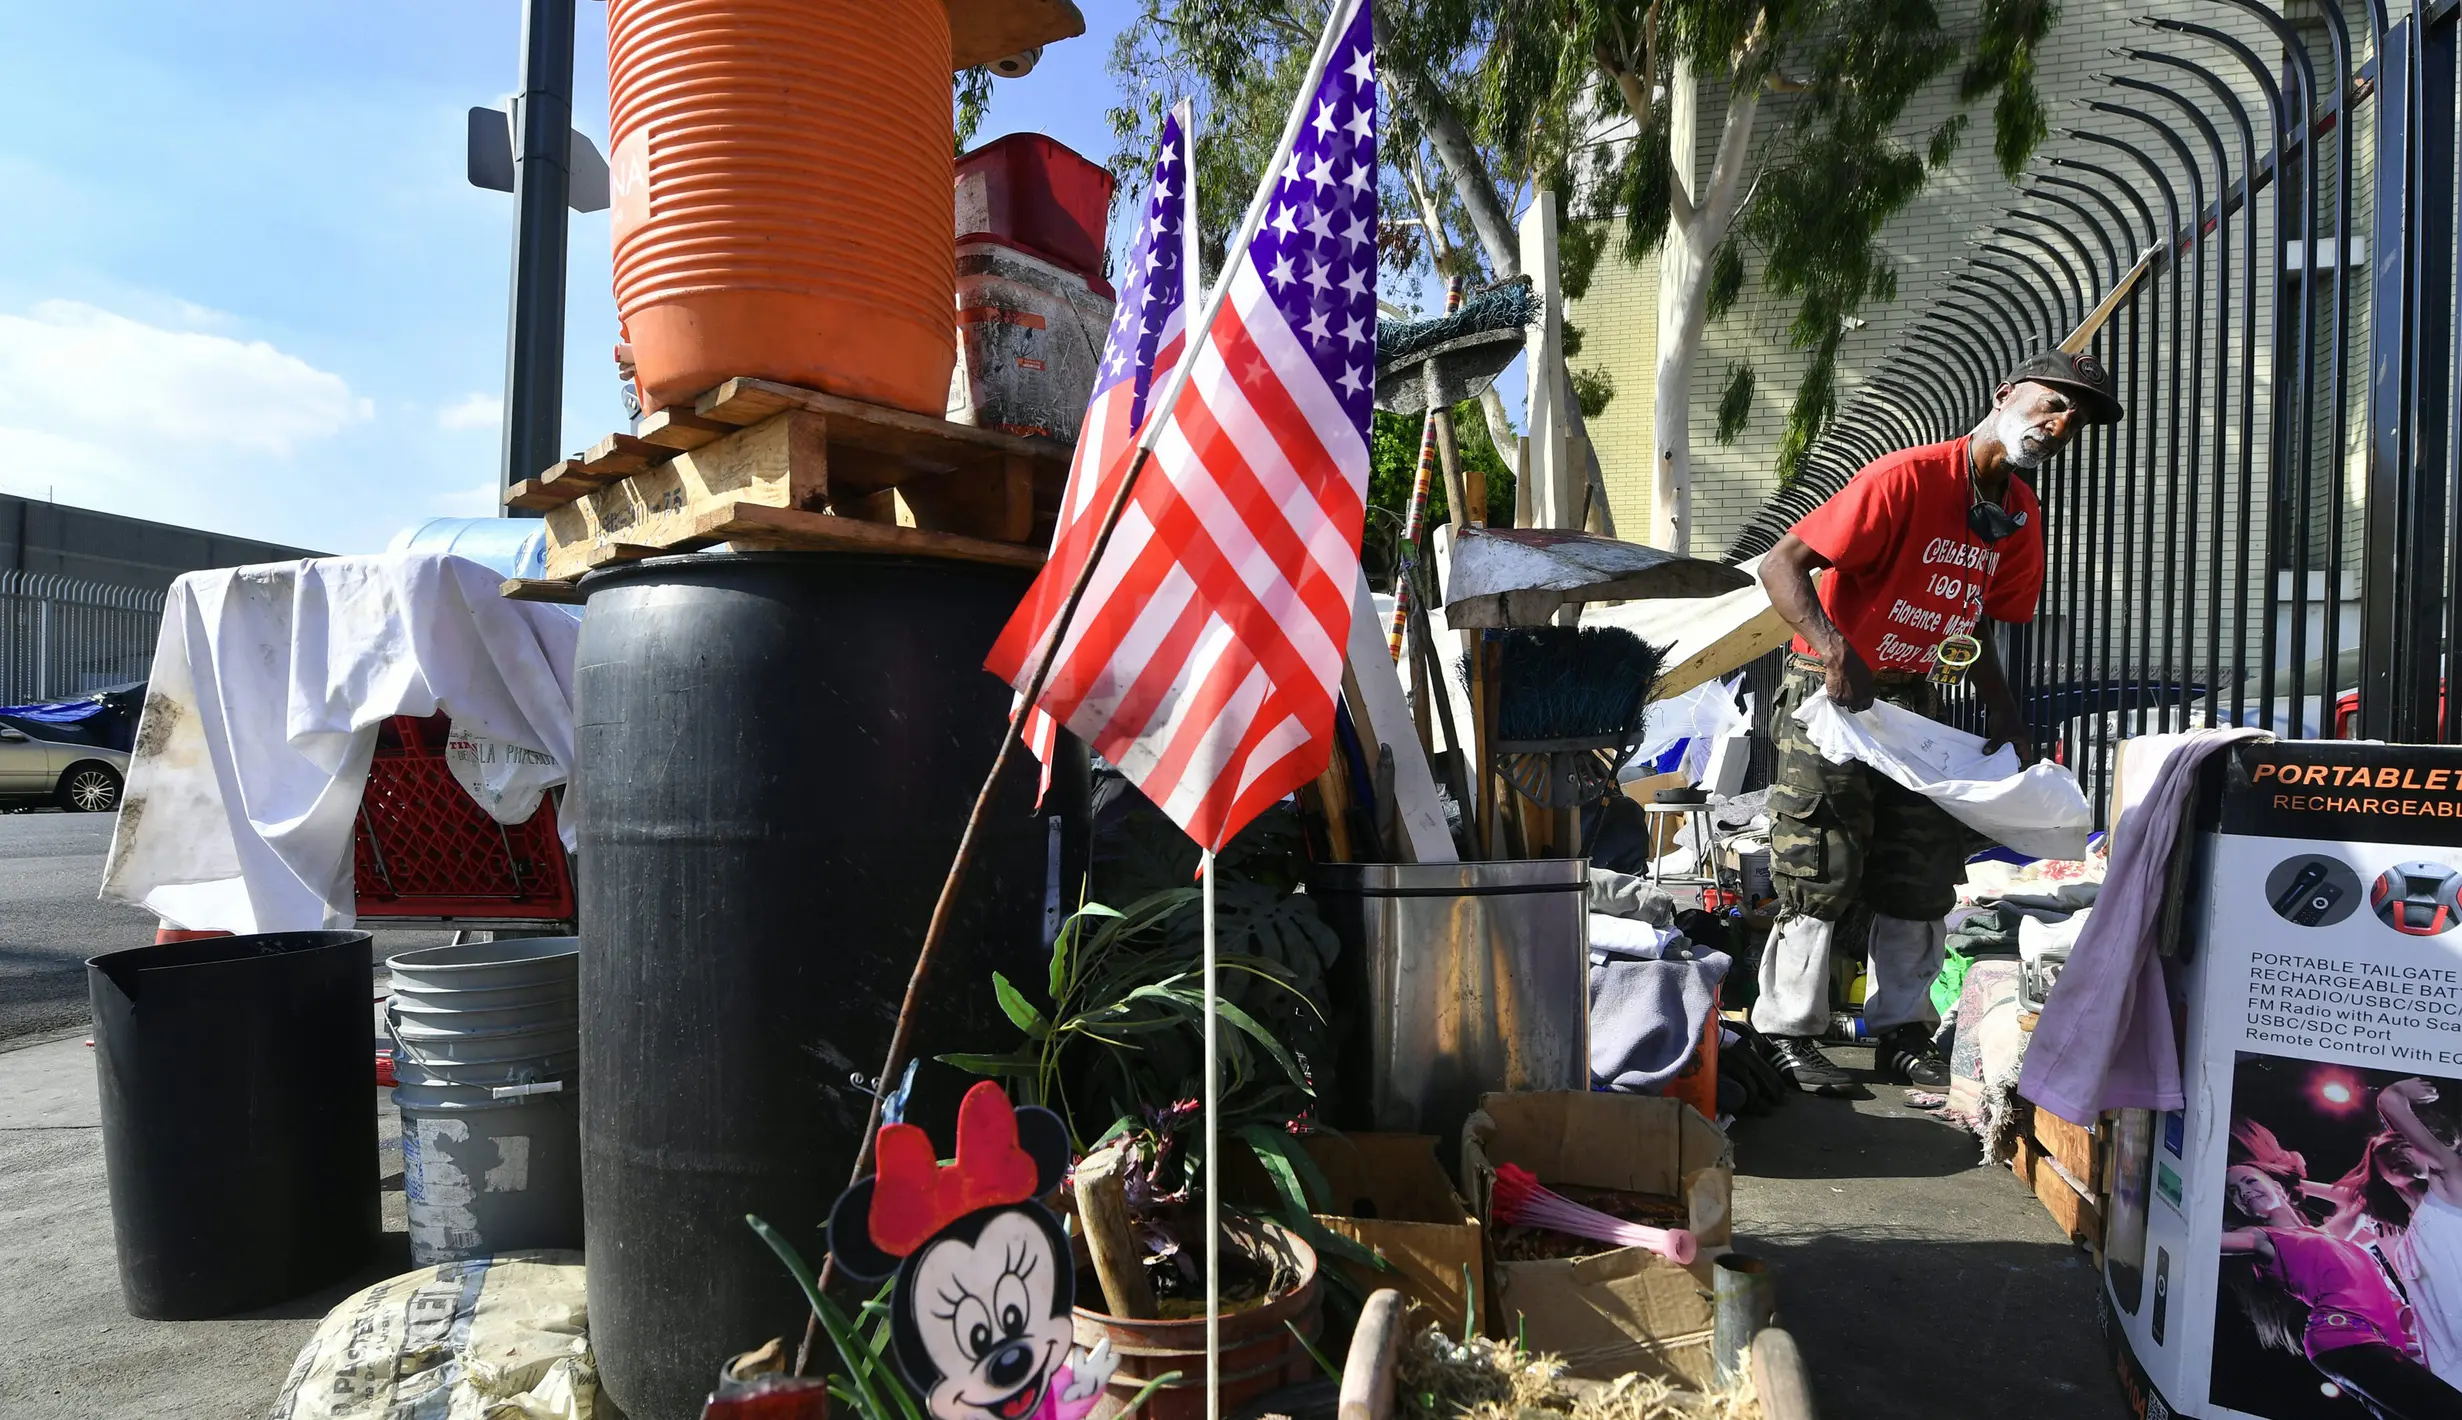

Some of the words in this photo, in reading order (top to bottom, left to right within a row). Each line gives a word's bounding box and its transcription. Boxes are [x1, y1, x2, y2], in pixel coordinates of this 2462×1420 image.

[1926, 573, 1962, 600] 100
[1887, 599, 1942, 632] Florence
[1876, 632, 1923, 663] Happy
[2250, 967, 2414, 995] RECHARGEABLE
[2420, 985, 2462, 999] BAT
[2251, 952, 2354, 973] PORTABLE
[2360, 962, 2457, 983] TAILGATE
[2249, 982, 2275, 996] FM
[2247, 1013, 2347, 1035] USBC/SDC
[2353, 1026, 2391, 1041] Port
[2248, 998, 2274, 1011] FM
[2280, 1001, 2331, 1017] Radio
[2337, 1009, 2373, 1023] with
[2377, 1013, 2420, 1028] Auto
[2246, 1027, 2313, 1047] Remote
[2319, 1037, 2385, 1056] Control
[2391, 1046, 2432, 1061] With
